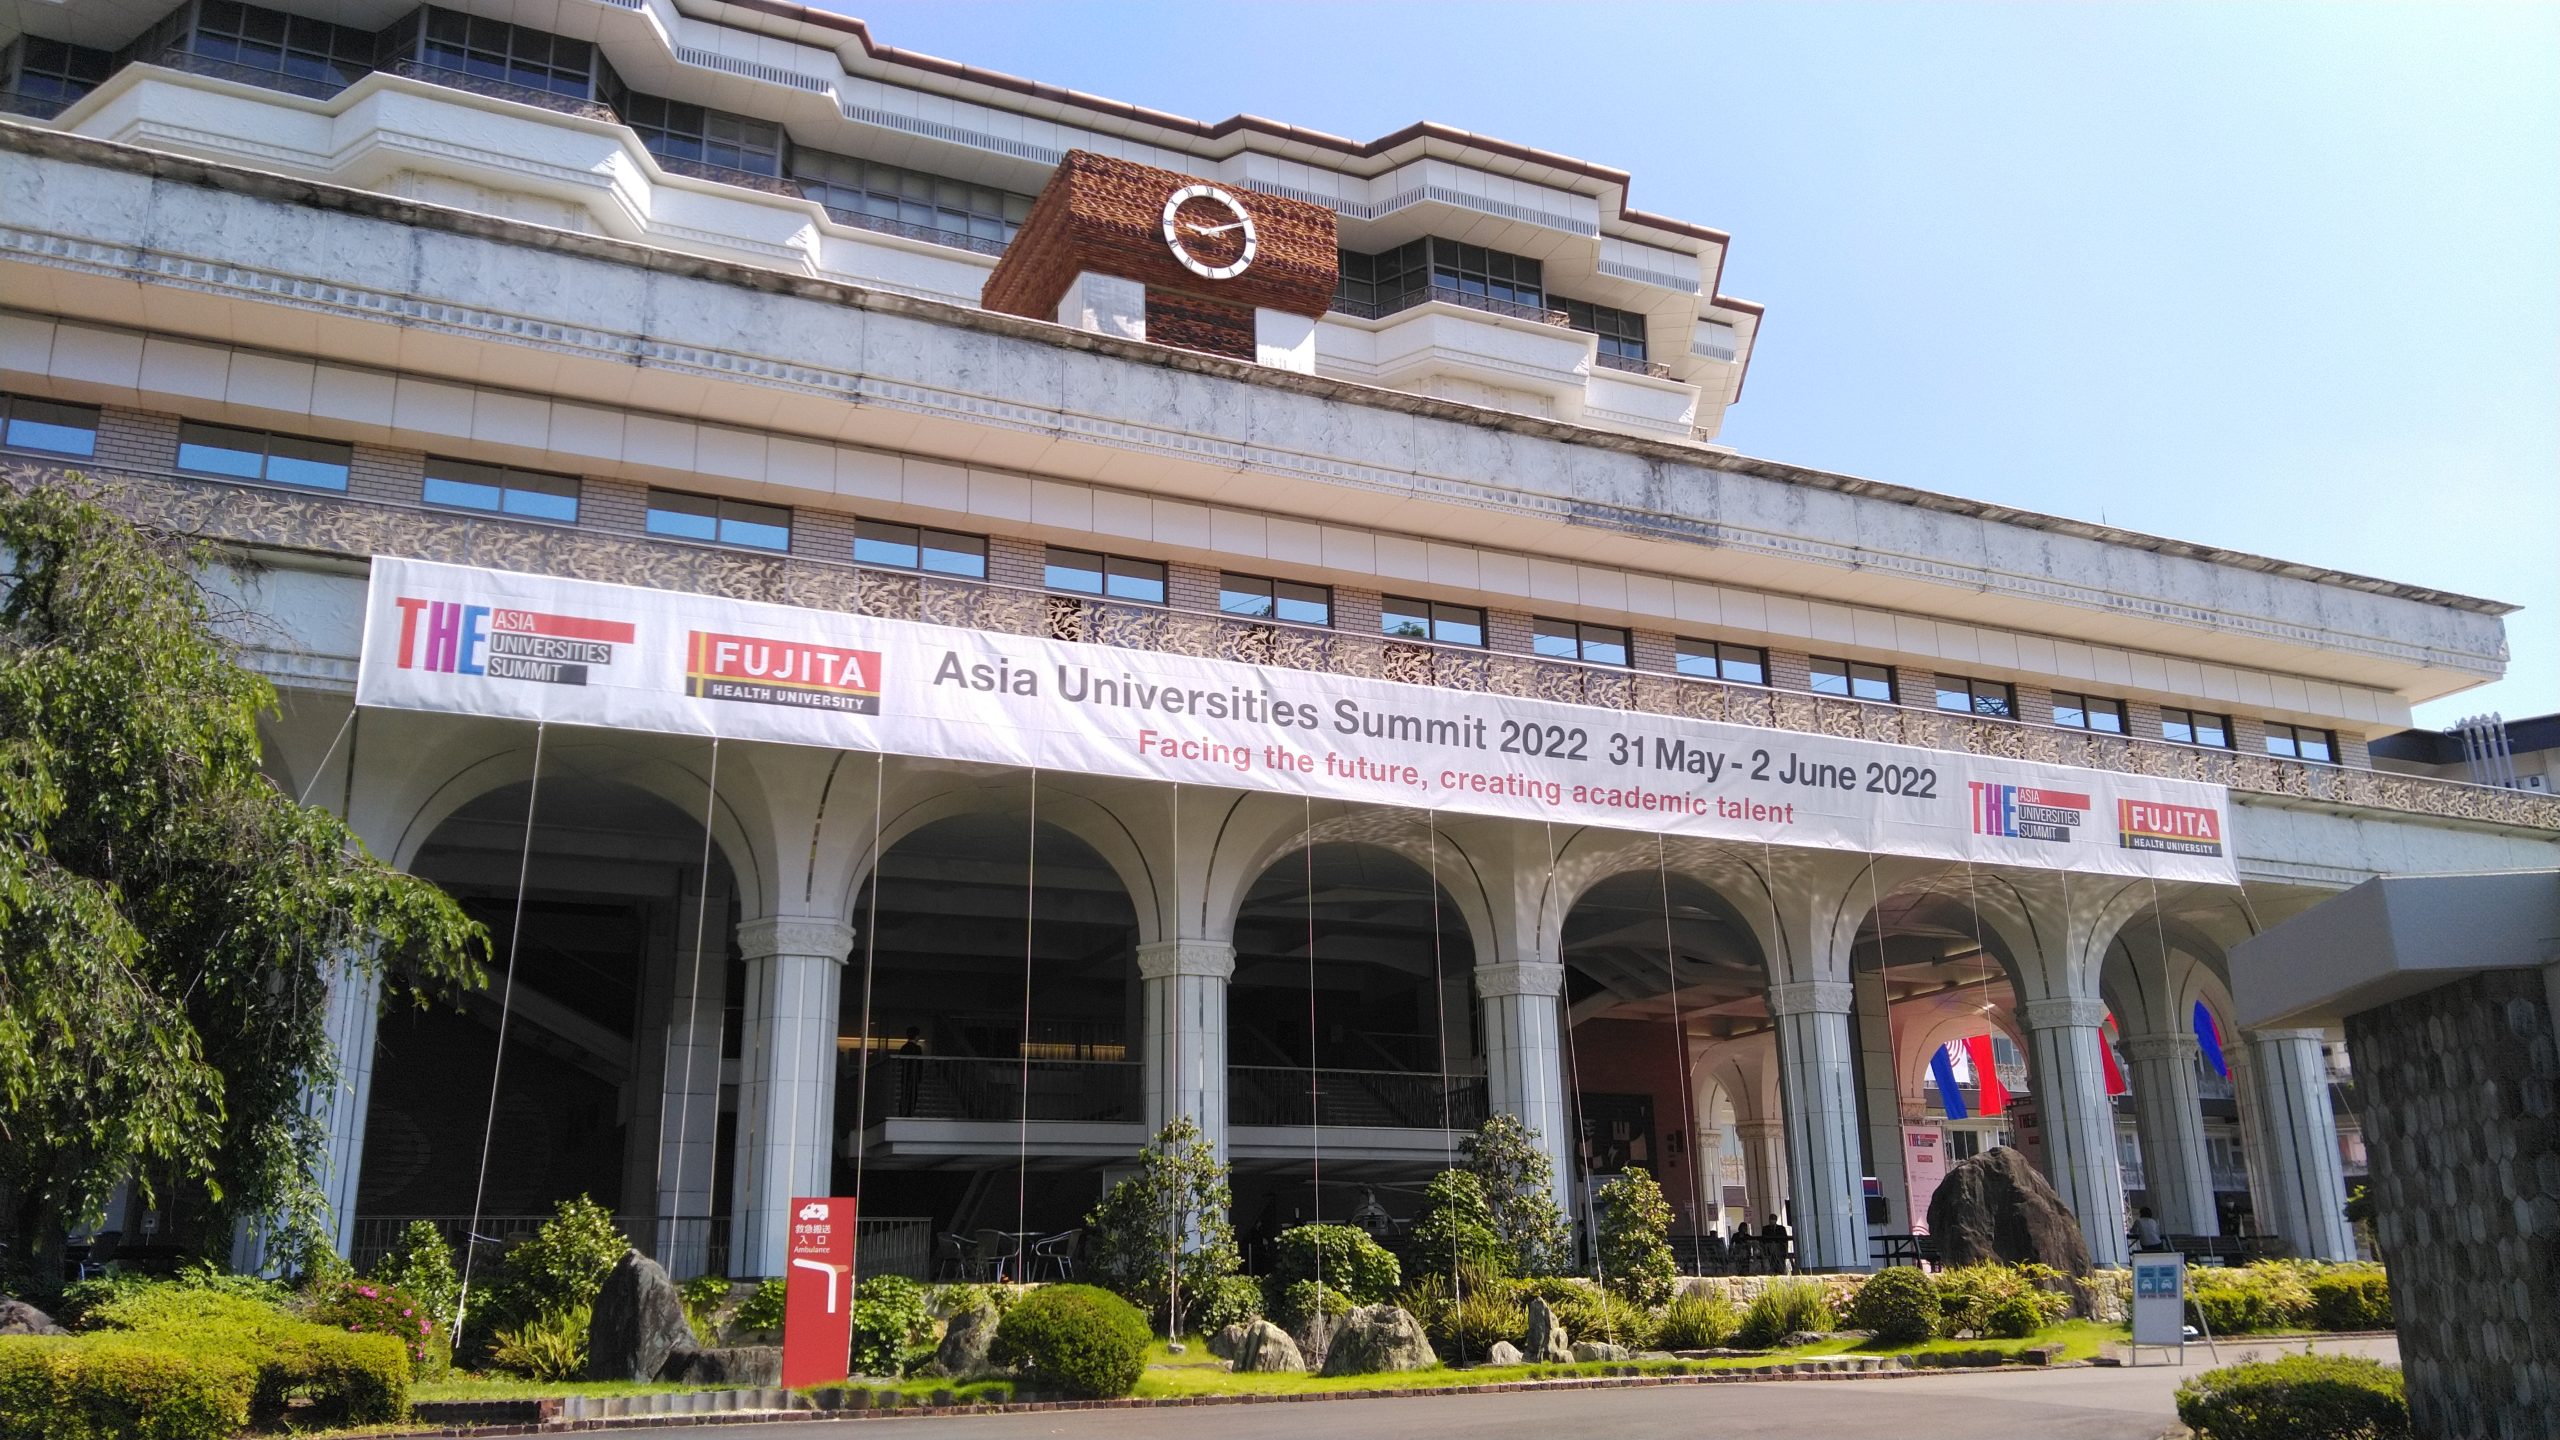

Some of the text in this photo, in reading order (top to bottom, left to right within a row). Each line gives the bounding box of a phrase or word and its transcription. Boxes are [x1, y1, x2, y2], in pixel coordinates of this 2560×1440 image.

[495, 611, 535, 631] ASIA
[396, 597, 490, 676] THE
[492, 634, 610, 664] UNIVERSITIES
[490, 657, 562, 682] SUMMIT
[715, 641, 865, 688] FUJITA
[713, 684, 864, 710] HEALTH UNIVERSITY
[933, 651, 1038, 697] Asia
[1057, 664, 1319, 731] Universities
[1333, 698, 1487, 750] Summit
[1500, 719, 1588, 761] 2022
[1608, 733, 1645, 767] 31
[1779, 752, 1857, 790] June
[1866, 761, 1937, 799] 2022
[1139, 730, 1794, 825] Facing the future, creating academic talent
[1968, 781, 2018, 838] THE
[2019, 788, 2040, 803] ASIA
[2019, 807, 2079, 825] UNIVERSITIES
[2132, 806, 2212, 837] FUJITA
[2020, 823, 2056, 840] SUMMIT
[2134, 837, 2213, 854] HEALTH UNIVERSITY
